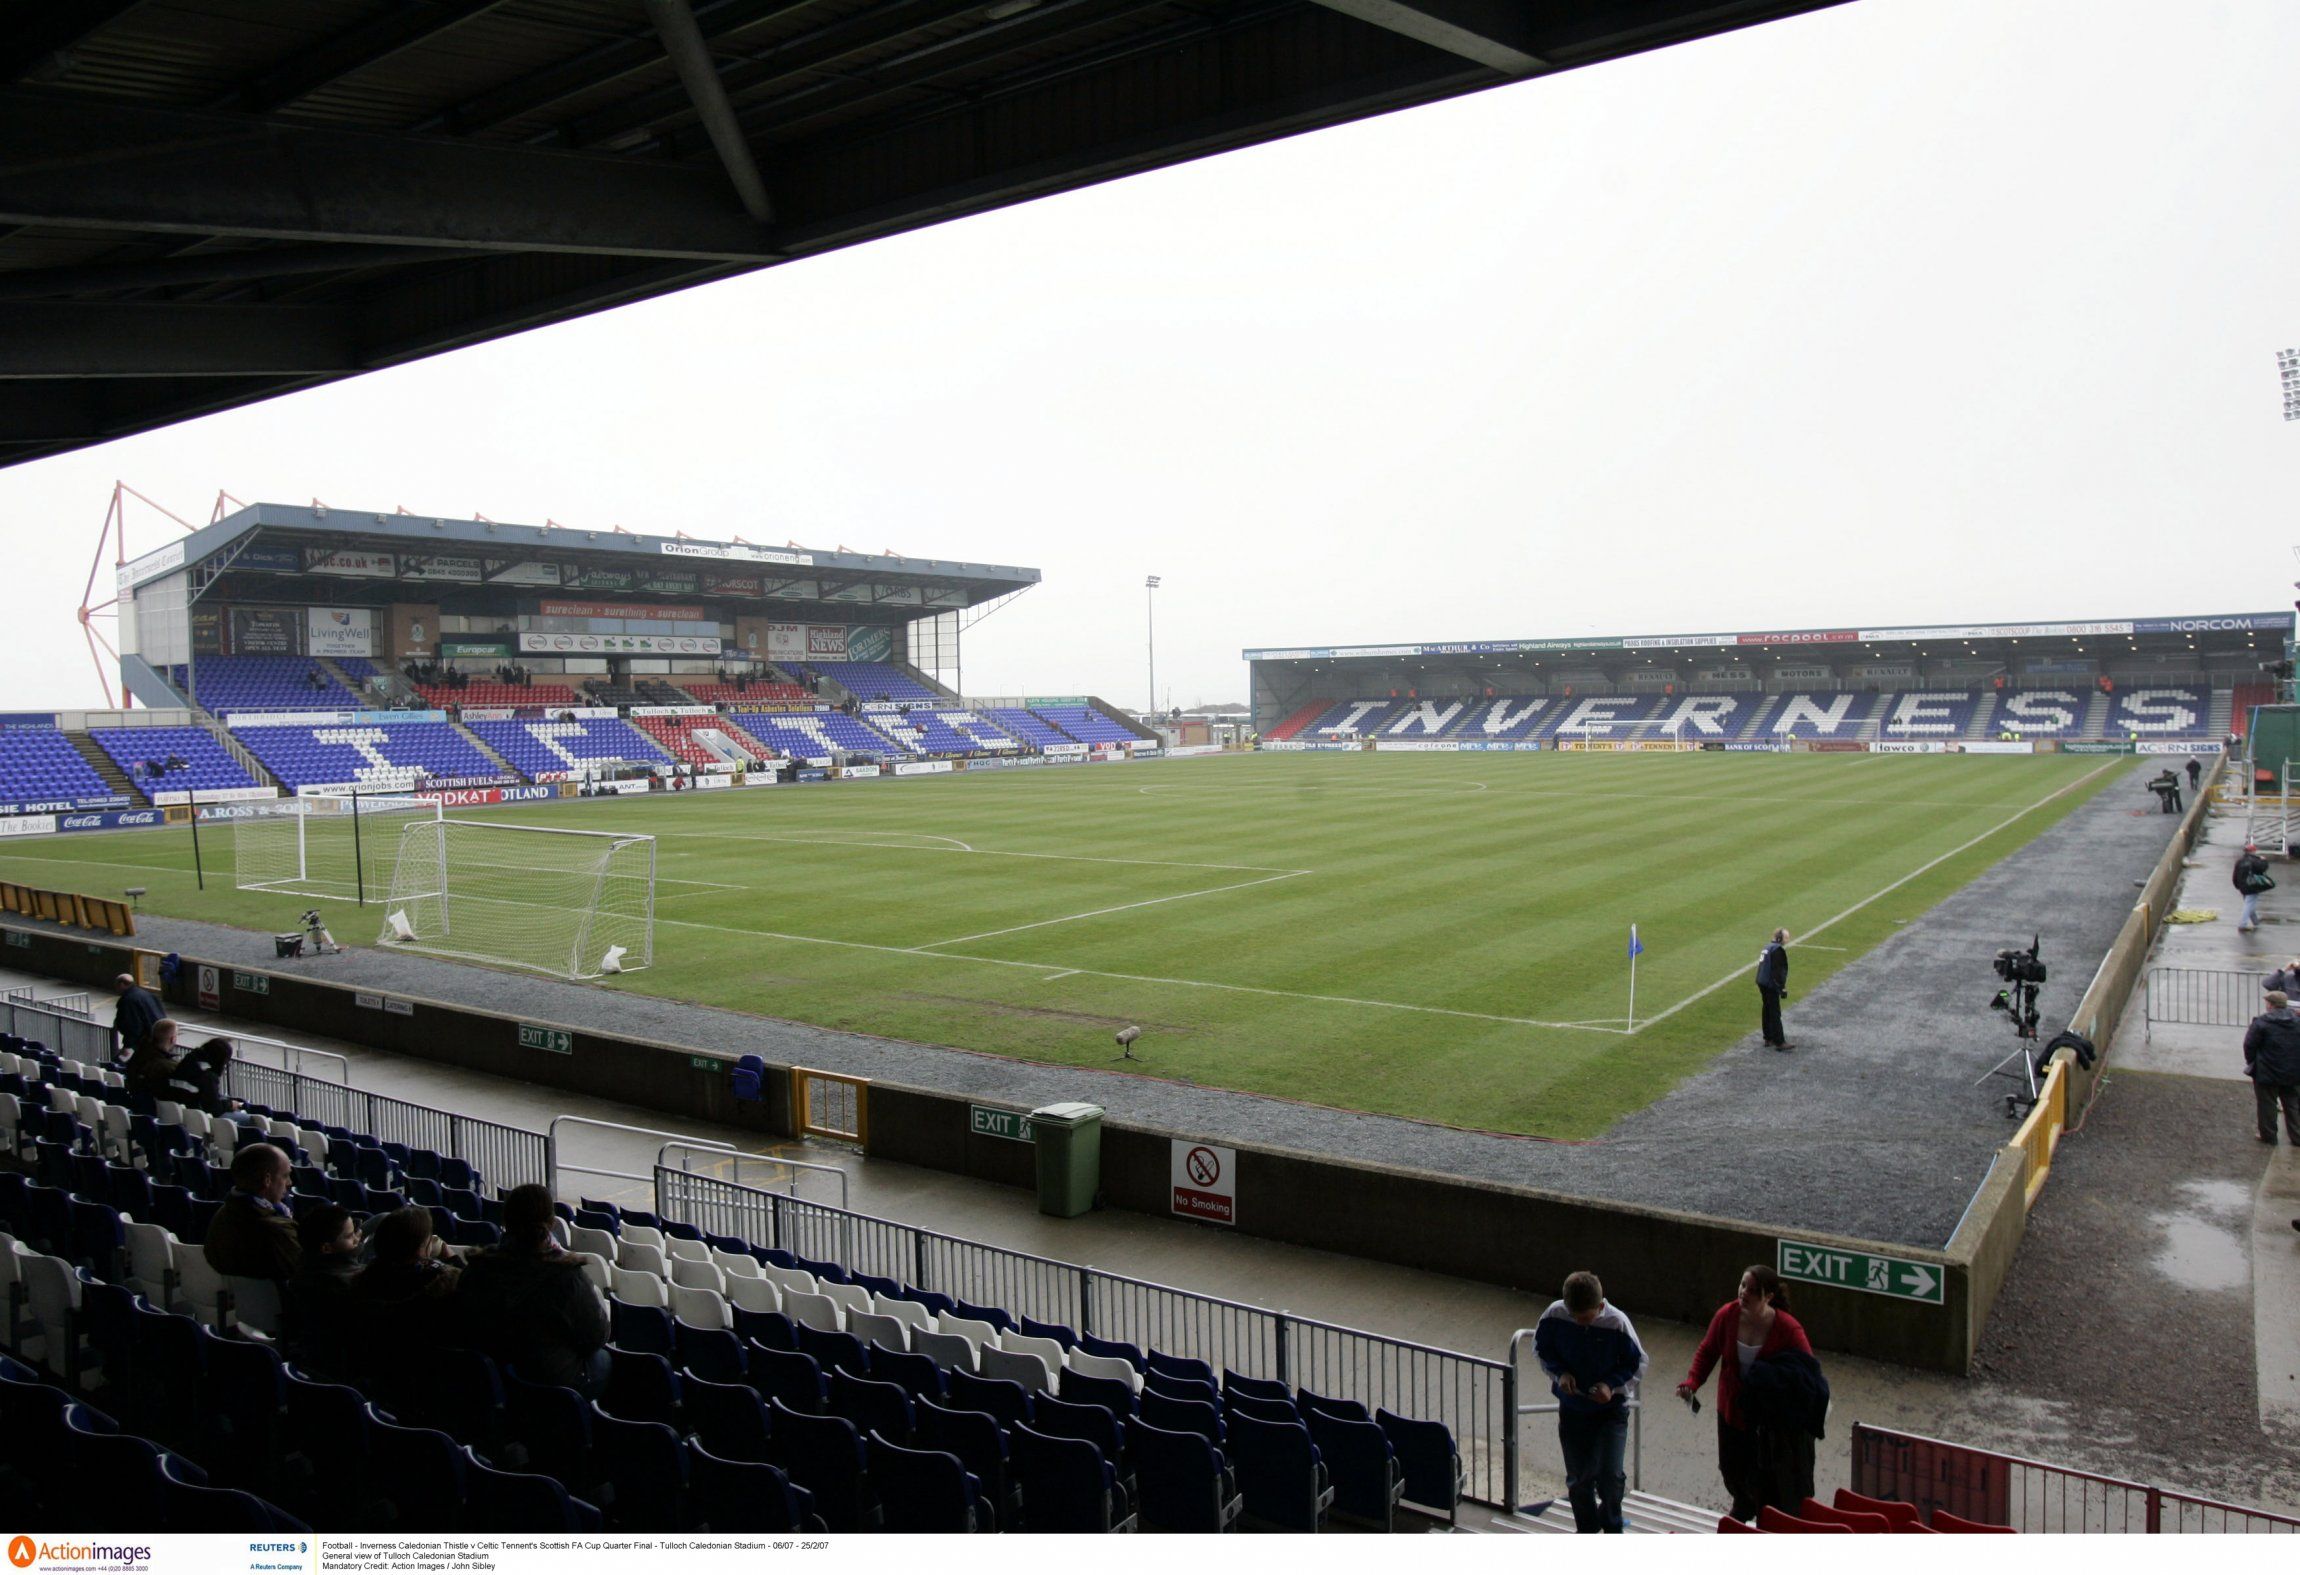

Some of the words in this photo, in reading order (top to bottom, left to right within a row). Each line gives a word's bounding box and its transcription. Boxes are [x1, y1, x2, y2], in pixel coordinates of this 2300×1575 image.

[665, 544, 728, 558] OrionGroup
[436, 559, 480, 569] PARCELS
[545, 605, 594, 616] sureclean
[604, 608, 648, 620] surething
[656, 609, 701, 619] sureclean
[2170, 619, 2252, 632] NORCOM
[310, 627, 370, 642] LivingWell
[810, 629, 844, 639] Highland
[456, 645, 497, 655] Europcar
[811, 639, 845, 652] NEWS
[1519, 642, 1546, 650] Highland
[1547, 641, 1572, 650] Airways
[1781, 670, 1822, 678] MOTORS
[862, 703, 893, 711] CORN
[894, 702, 931, 710] SIGNS
[1318, 690, 2197, 734] INVERNESS
[2190, 743, 2221, 752] SIGNS
[323, 781, 414, 793] www.orionjobs.com
[425, 777, 466, 790] SCOTTISH
[468, 776, 493, 788] FUELS
[417, 790, 491, 806] VODKAT
[500, 787, 548, 800] OTLAND
[25, 802, 75, 813] HOTEL
[200, 805, 254, 819] A.ROSS
[234, 974, 251, 987] EXIT
[386, 1002, 409, 1011] CATERING
[520, 1027, 543, 1045] EXIT
[693, 1057, 708, 1069] EXIT
[974, 1109, 1012, 1134] EXIT
[1176, 1194, 1188, 1206] No
[1191, 1197, 1230, 1216] Smoking
[1783, 1247, 1853, 1281] EXIT
